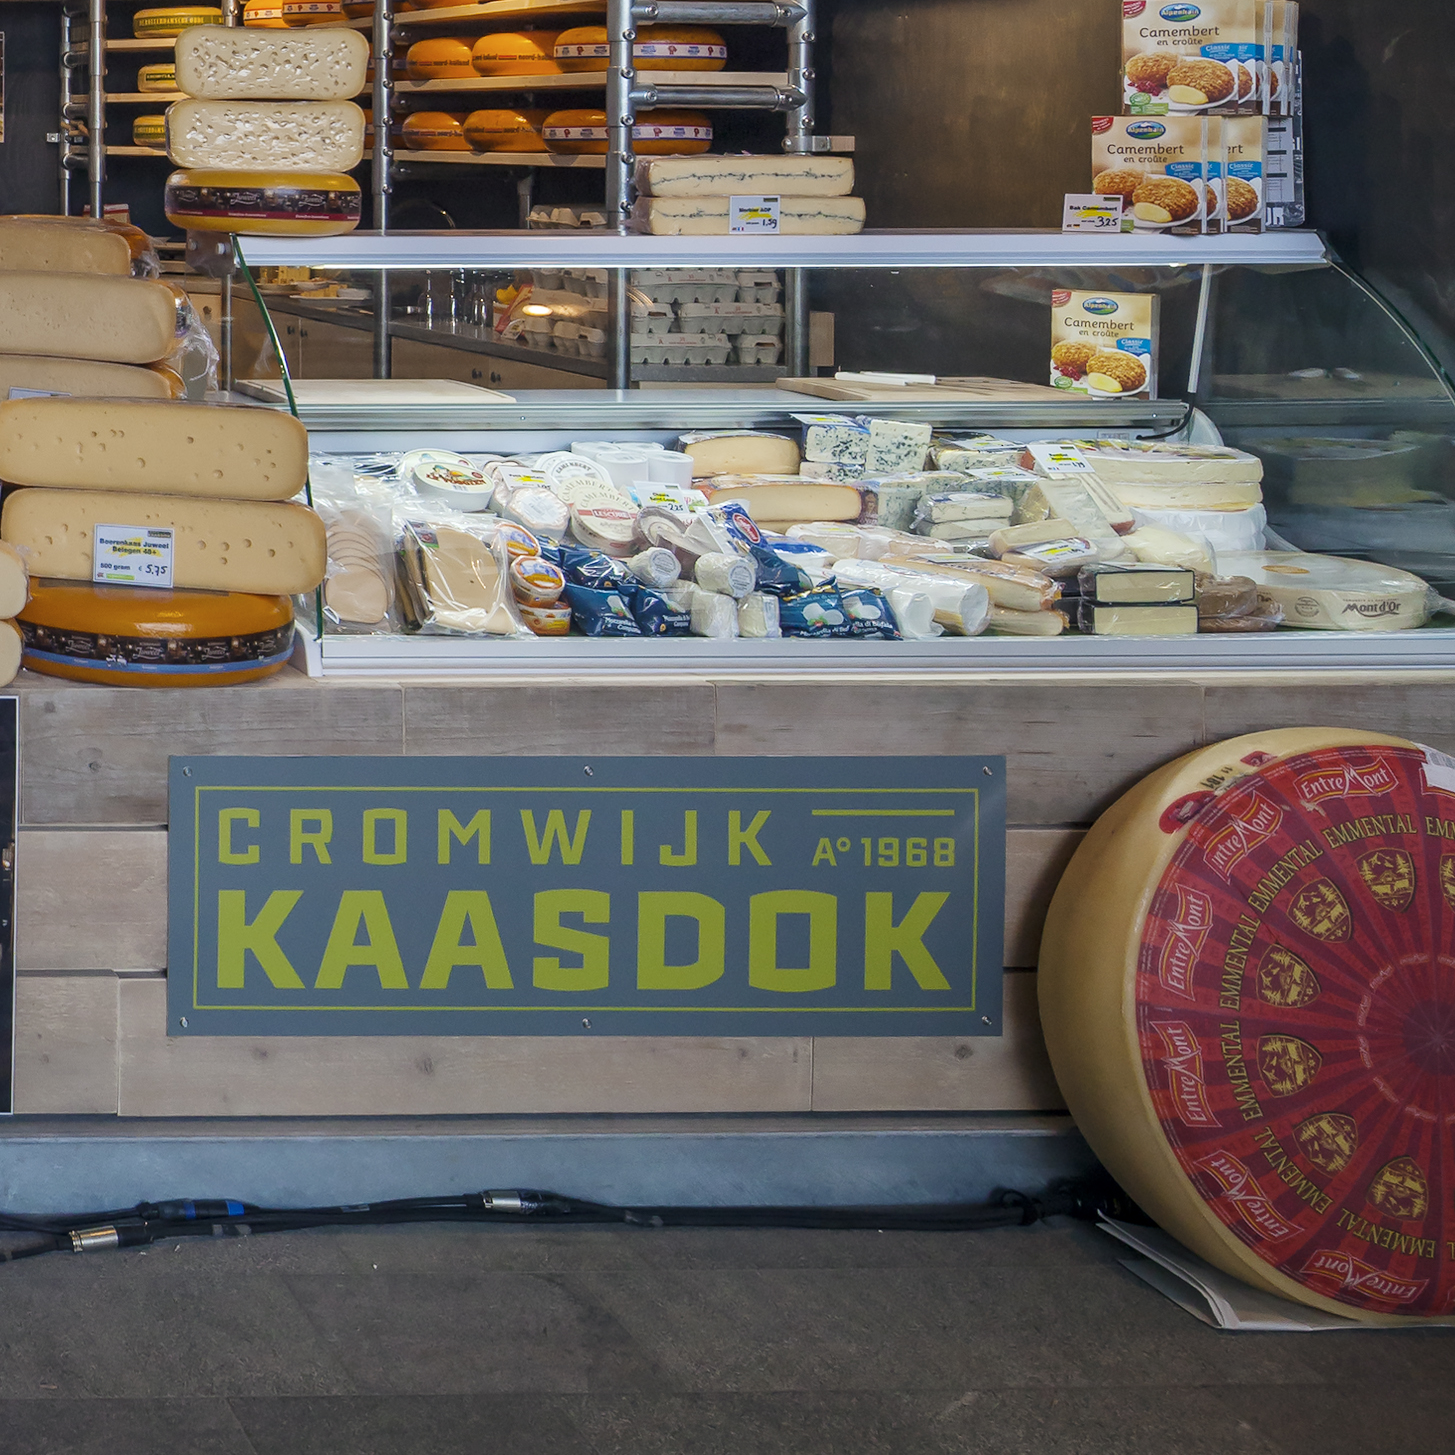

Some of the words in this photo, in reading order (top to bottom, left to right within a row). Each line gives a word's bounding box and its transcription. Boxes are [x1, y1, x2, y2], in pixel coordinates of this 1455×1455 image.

[1139, 26, 1220, 38] Camembert
[1172, 37, 1203, 46] croûte
[1107, 143, 1184, 155] Camembert
[1138, 154, 1168, 163] croûte
[1064, 317, 1135, 330] Camembert
[1092, 330, 1119, 338] croûte
[99, 538, 141, 546] Boerenkaas
[143, 541, 169, 549] Juweel
[1300, 762, 1391, 797] EntreMont
[218, 807, 773, 867] CROMWIJK
[862, 836, 956, 867] 1968
[1322, 814, 1418, 850] EMMENTAL
[1247, 838, 1325, 914] EMMENTAL
[217, 888, 952, 993] KAASDOK
[1219, 912, 1262, 1012] EMMENTAL
[1219, 1020, 1263, 1122] EMMENTAL
[1254, 1125, 1334, 1215] EMMENTAL
[1336, 1207, 1437, 1259] EMMENTAL
